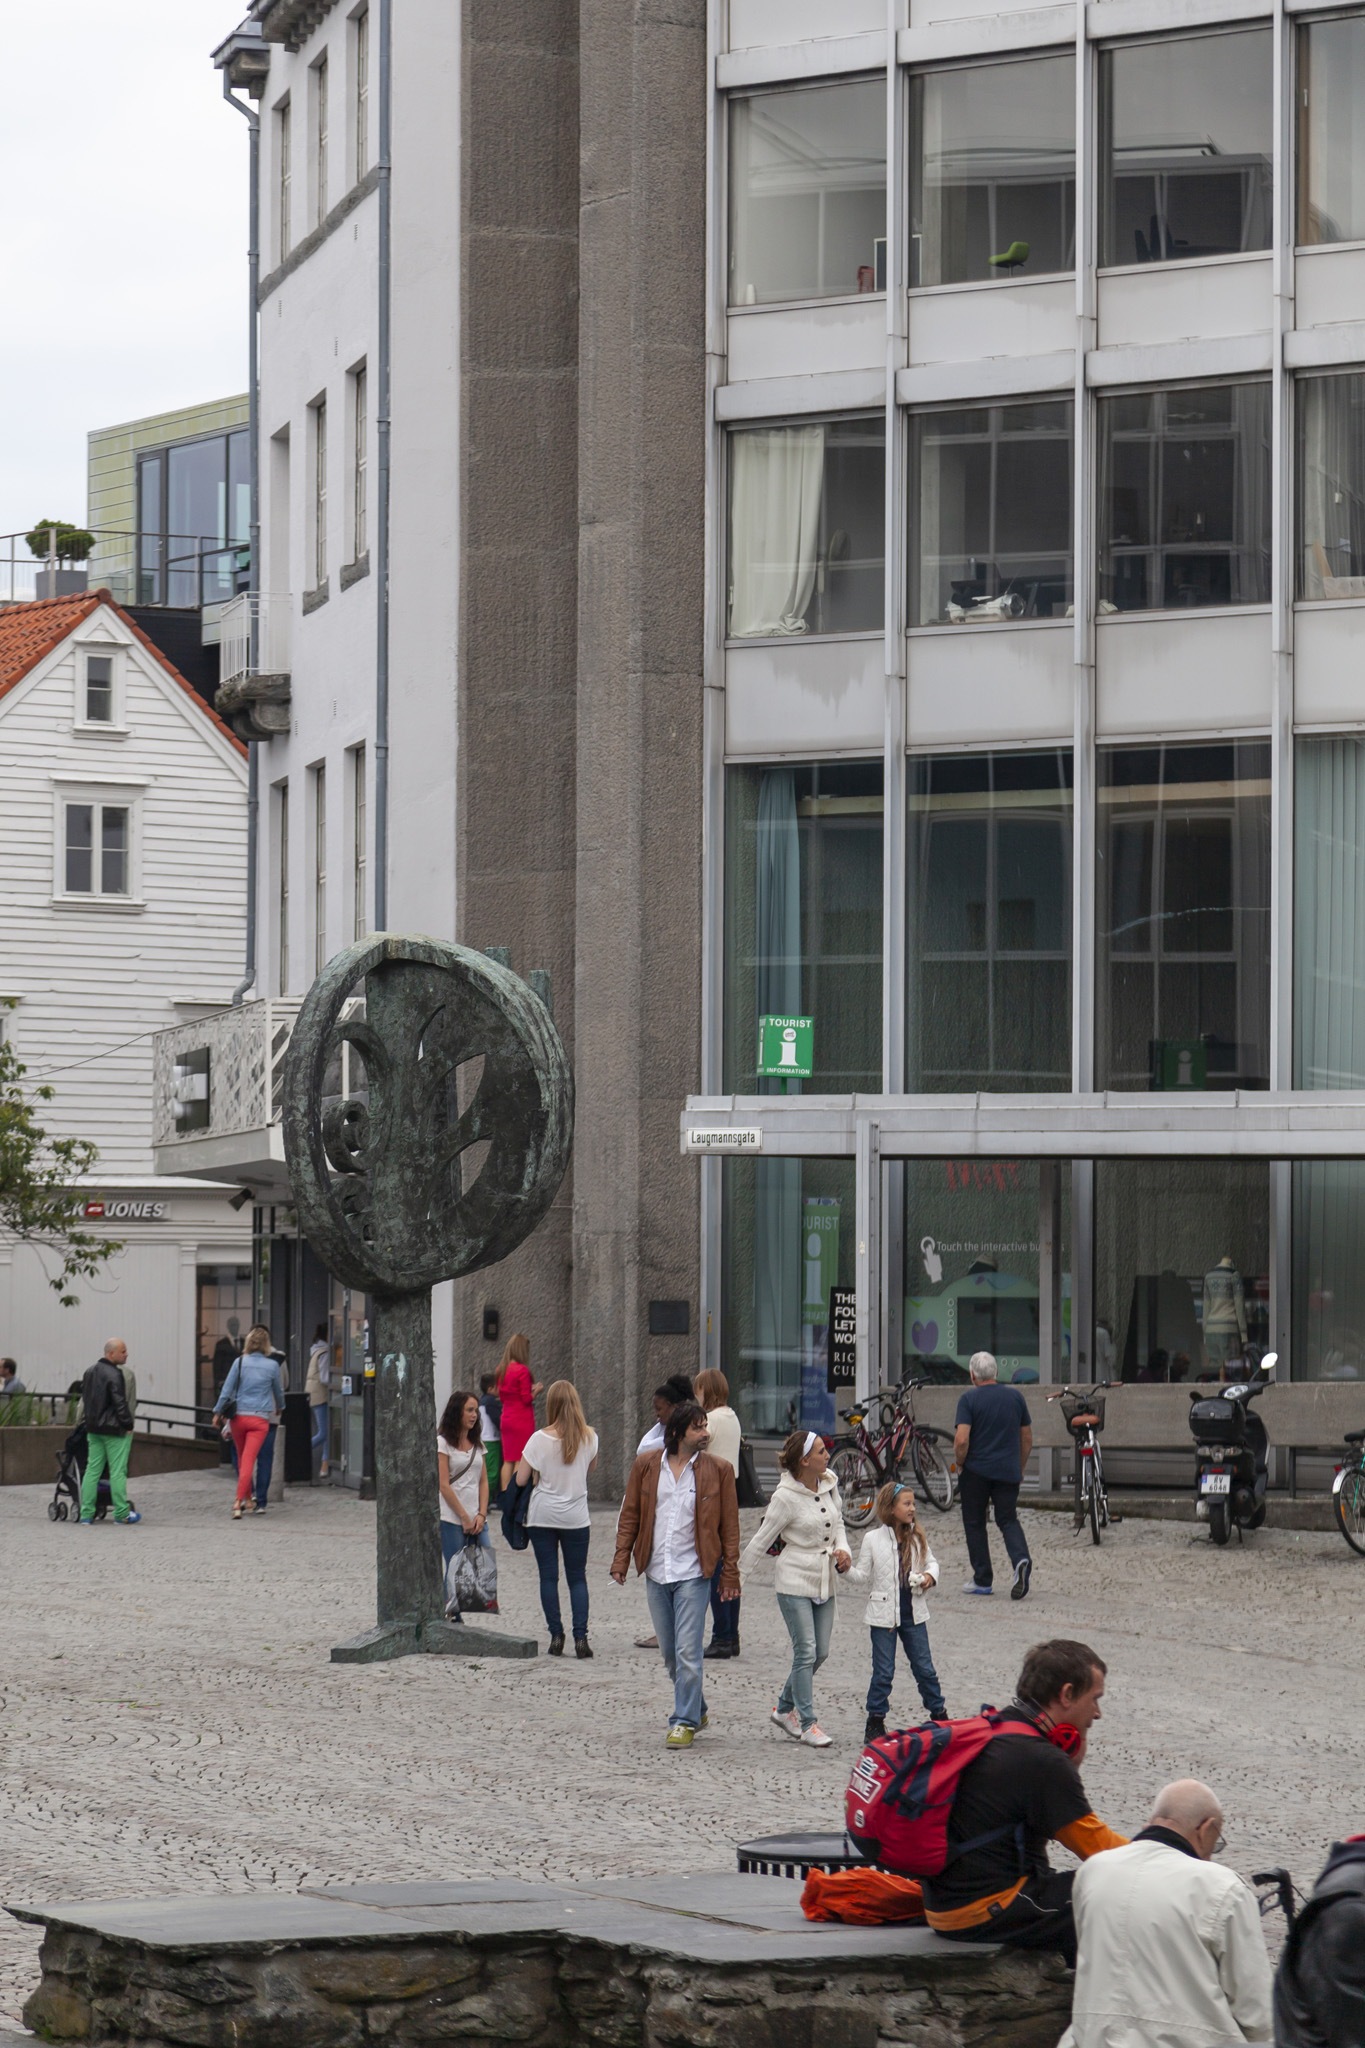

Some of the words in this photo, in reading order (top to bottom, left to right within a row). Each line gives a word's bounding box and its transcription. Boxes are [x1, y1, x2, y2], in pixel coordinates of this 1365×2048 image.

[769, 1018, 811, 1028] TOURIST
[766, 1067, 810, 1075] INFORMATION
[691, 1130, 756, 1147] Laugmannsgata
[105, 1202, 165, 1217] JONES
[803, 1215, 839, 1231] URIST
[937, 1241, 962, 1252] Touch
[964, 1241, 979, 1252] the
[981, 1241, 1027, 1252] interactive
